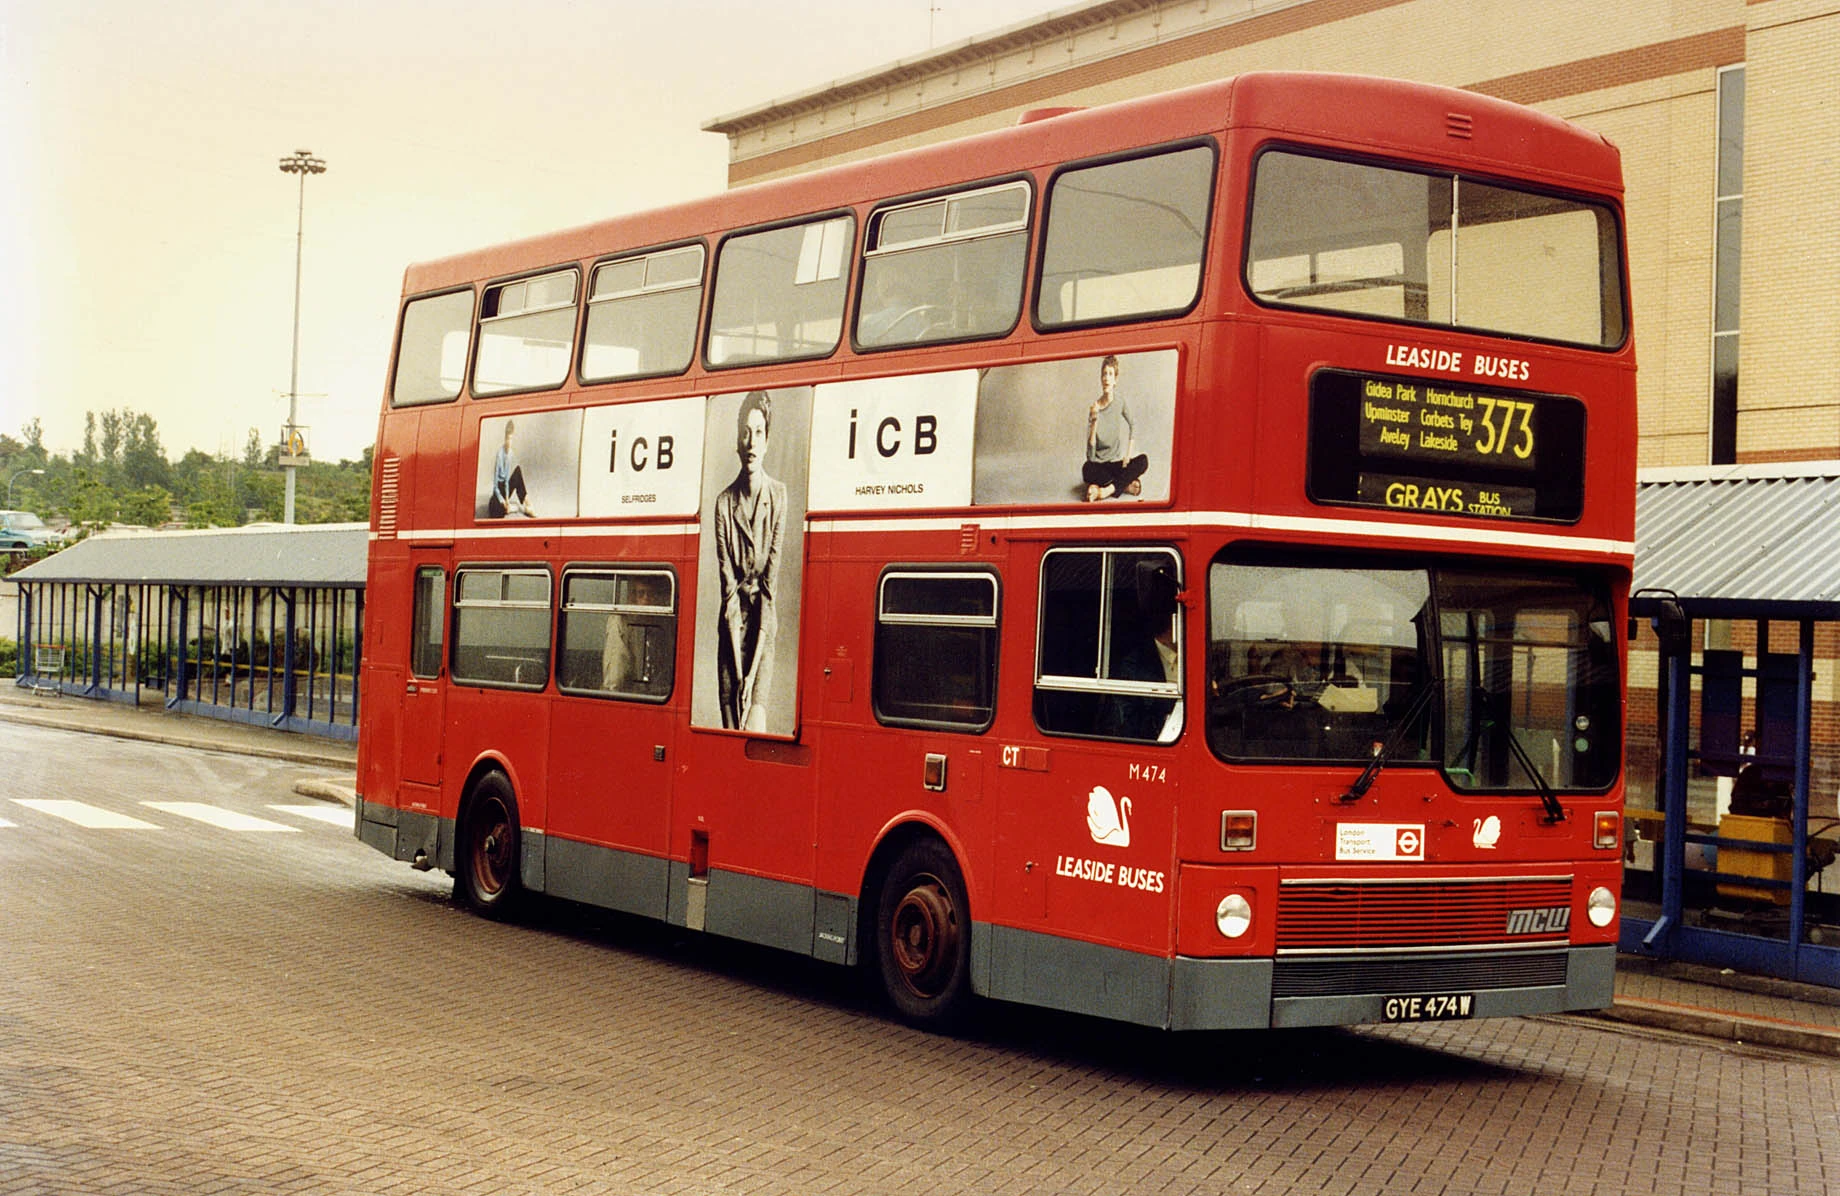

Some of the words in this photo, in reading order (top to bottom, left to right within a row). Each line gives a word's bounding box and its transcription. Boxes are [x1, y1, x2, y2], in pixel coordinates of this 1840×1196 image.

[1386, 344, 1462, 372] LEASIDE
[1474, 355, 1530, 380] BUSES
[1365, 380, 1392, 399] Gidea
[1396, 384, 1416, 402] Park
[1426, 387, 1474, 409] Hornchurch
[1365, 401, 1411, 423] Upminster
[1420, 408, 1454, 429] Corbets
[1459, 413, 1473, 436] Tey
[1475, 397, 1535, 459] 373
[1380, 426, 1410, 451] Aveley
[1420, 431, 1458, 451] Lakeside
[621, 494, 657, 504] SELFRIDGES
[855, 485, 886, 496] HARVEY
[888, 483, 924, 494] NICHOLS
[1385, 482, 1464, 512] GRAYS
[1479, 491, 1501, 505] BUS
[1467, 503, 1511, 516] STATION
[1002, 745, 1020, 767] CT
[1056, 855, 1114, 884] LEASIDE
[1117, 868, 1165, 893] BUSES
[1386, 998, 1422, 1019] GYE
